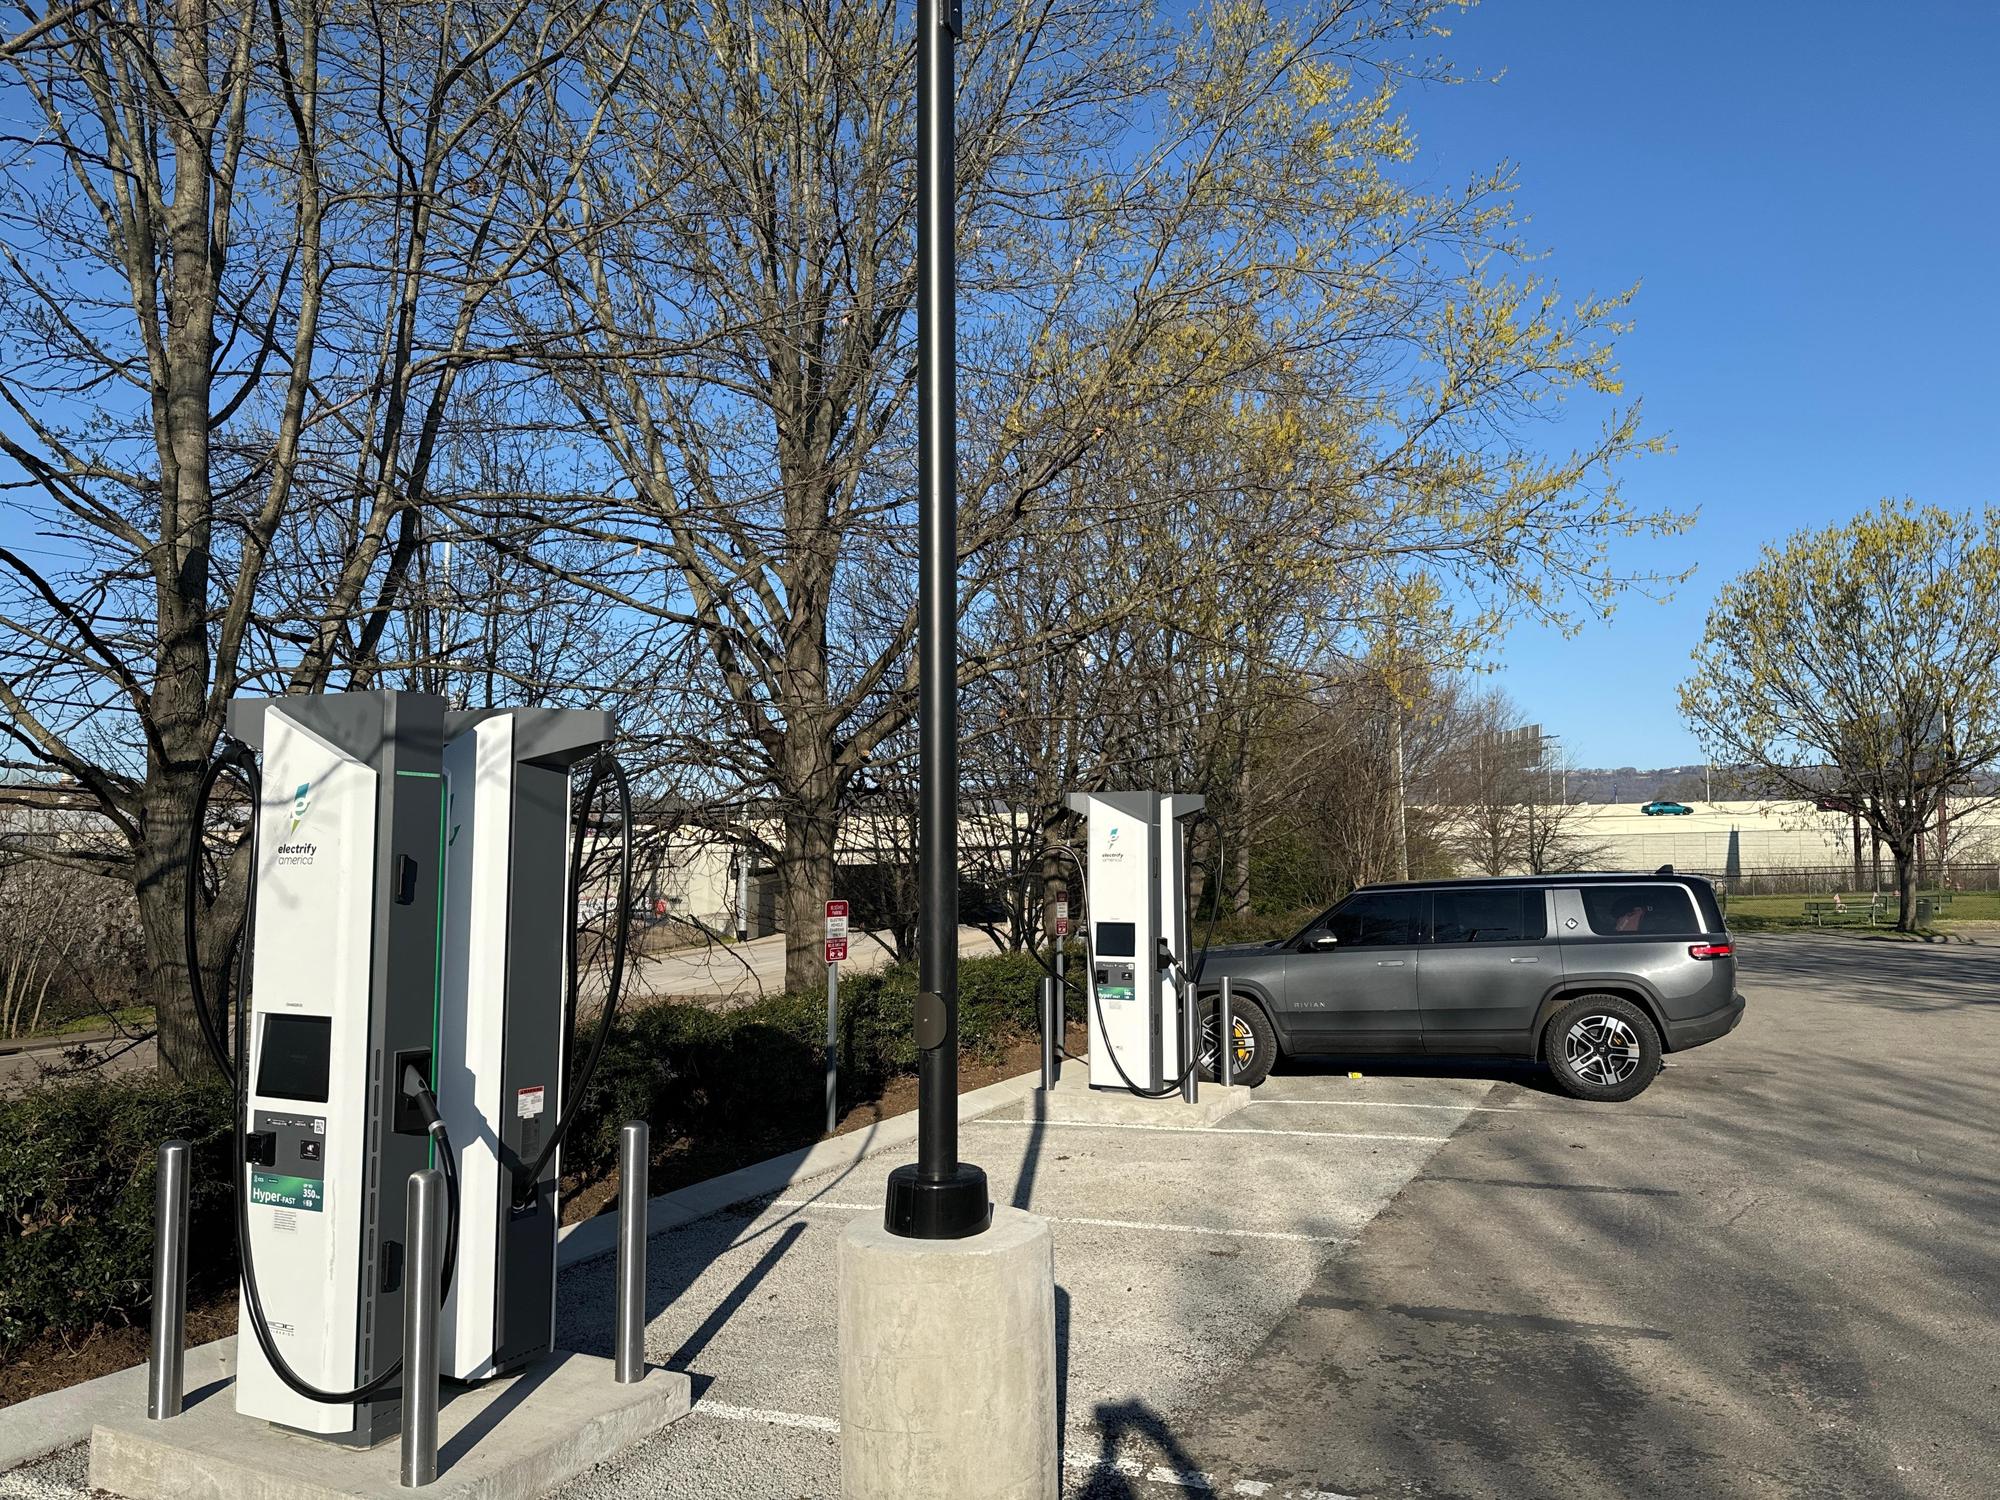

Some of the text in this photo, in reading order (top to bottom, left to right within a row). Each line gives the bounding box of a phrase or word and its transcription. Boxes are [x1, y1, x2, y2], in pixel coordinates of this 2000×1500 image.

[278, 843, 317, 856] electrify
[278, 856, 314, 865] america
[303, 1189, 316, 1198] 350
